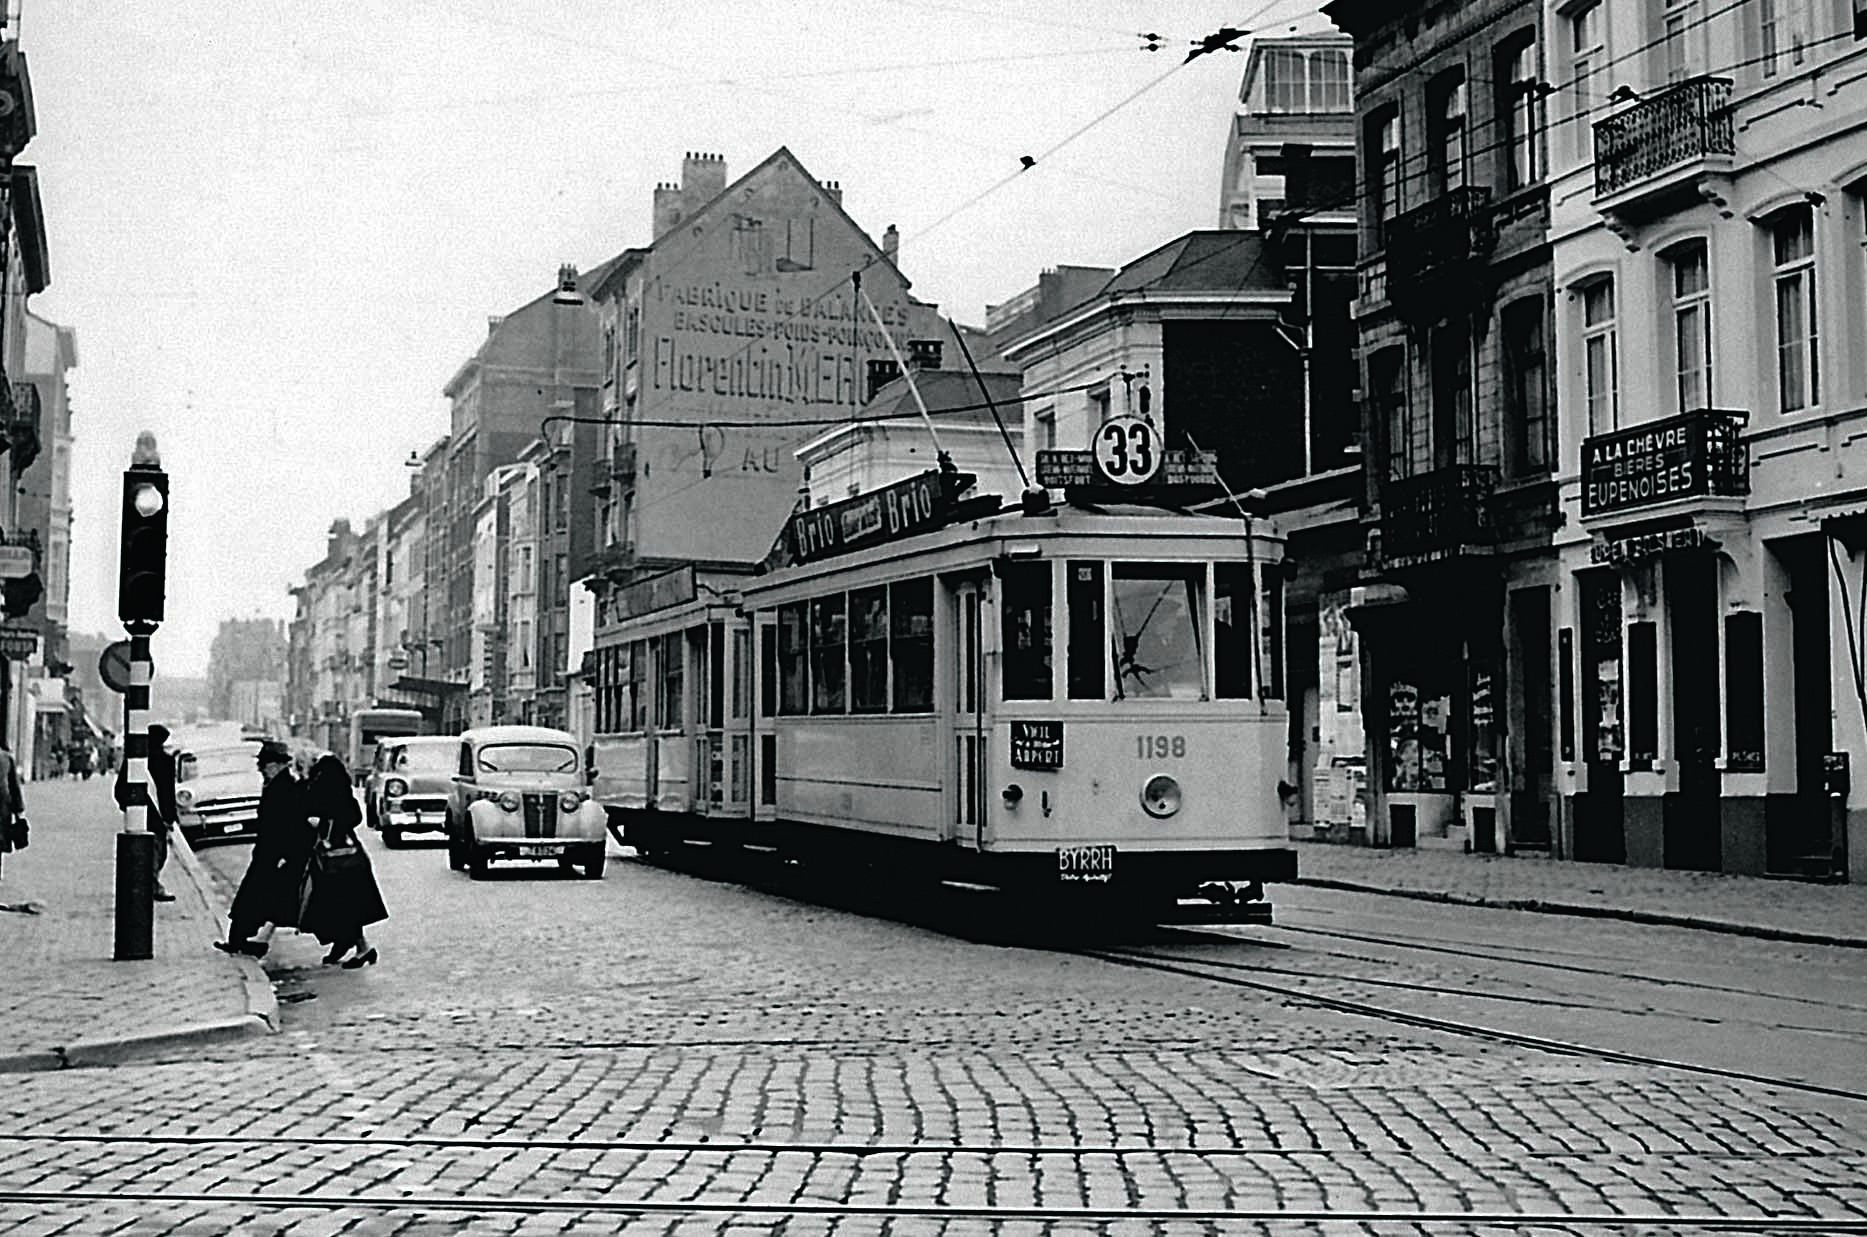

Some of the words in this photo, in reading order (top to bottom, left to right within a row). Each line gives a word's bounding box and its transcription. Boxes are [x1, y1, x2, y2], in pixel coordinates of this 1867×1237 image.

[1104, 424, 1152, 476] 33
[1592, 448, 1601, 464] A
[1606, 443, 1622, 461] LA
[1588, 461, 1692, 508] EUPENOISES
[887, 482, 931, 534] Brio
[796, 512, 834, 557] Brio
[1137, 735, 1186, 760] 1198
[1058, 847, 1113, 871] BYRRH
